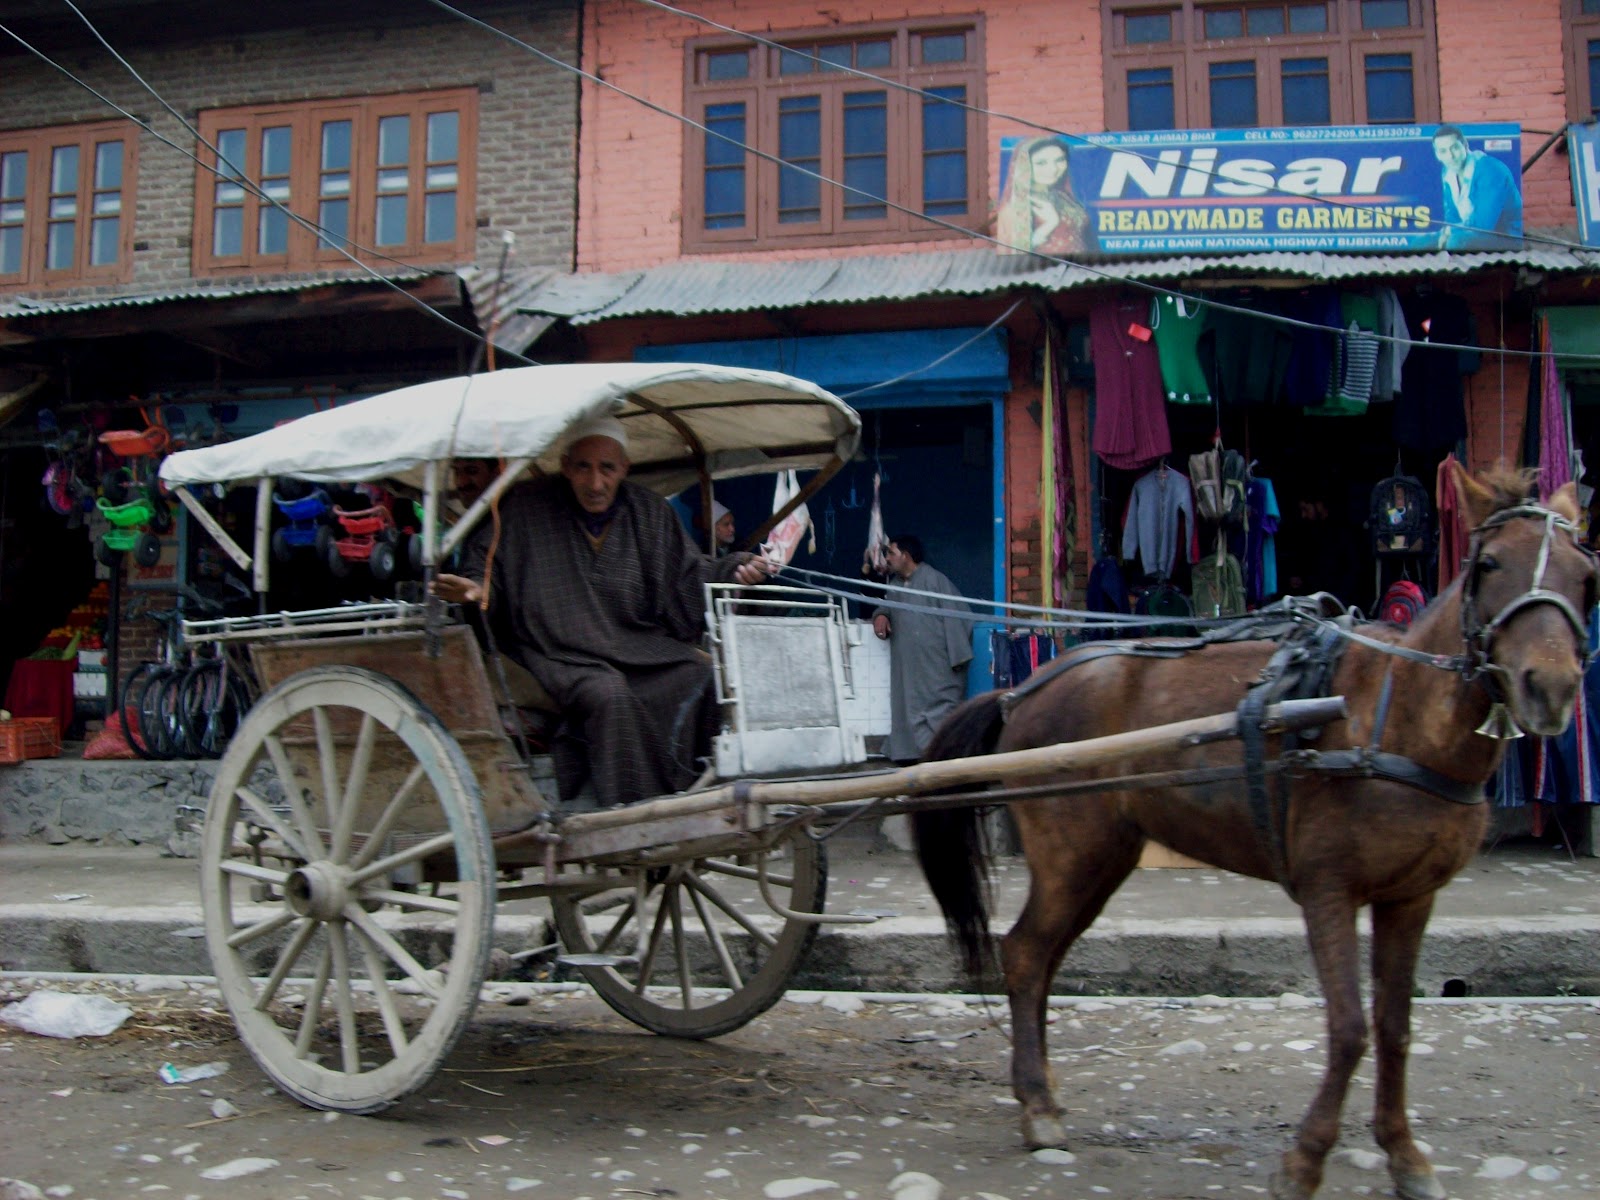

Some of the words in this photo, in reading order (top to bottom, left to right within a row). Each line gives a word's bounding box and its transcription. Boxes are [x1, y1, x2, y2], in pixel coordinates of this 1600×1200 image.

[1121, 134, 1150, 143] NISAR
[1152, 133, 1189, 142] AHMAD
[1191, 132, 1217, 141] BHAT
[1244, 131, 1268, 140] CELL
[1099, 147, 1403, 199] Nisar
[1098, 207, 1264, 233] READYMADE
[1276, 206, 1431, 230] GARMENTS
[1105, 239, 1139, 249] NEAR
[1141, 239, 1165, 249] J&K
[1168, 238, 1203, 248] BANK
[1206, 237, 1270, 248] NATIONAL
[1273, 237, 1334, 247] HIGHWAY
[1337, 236, 1409, 247] BIJBEHARA
